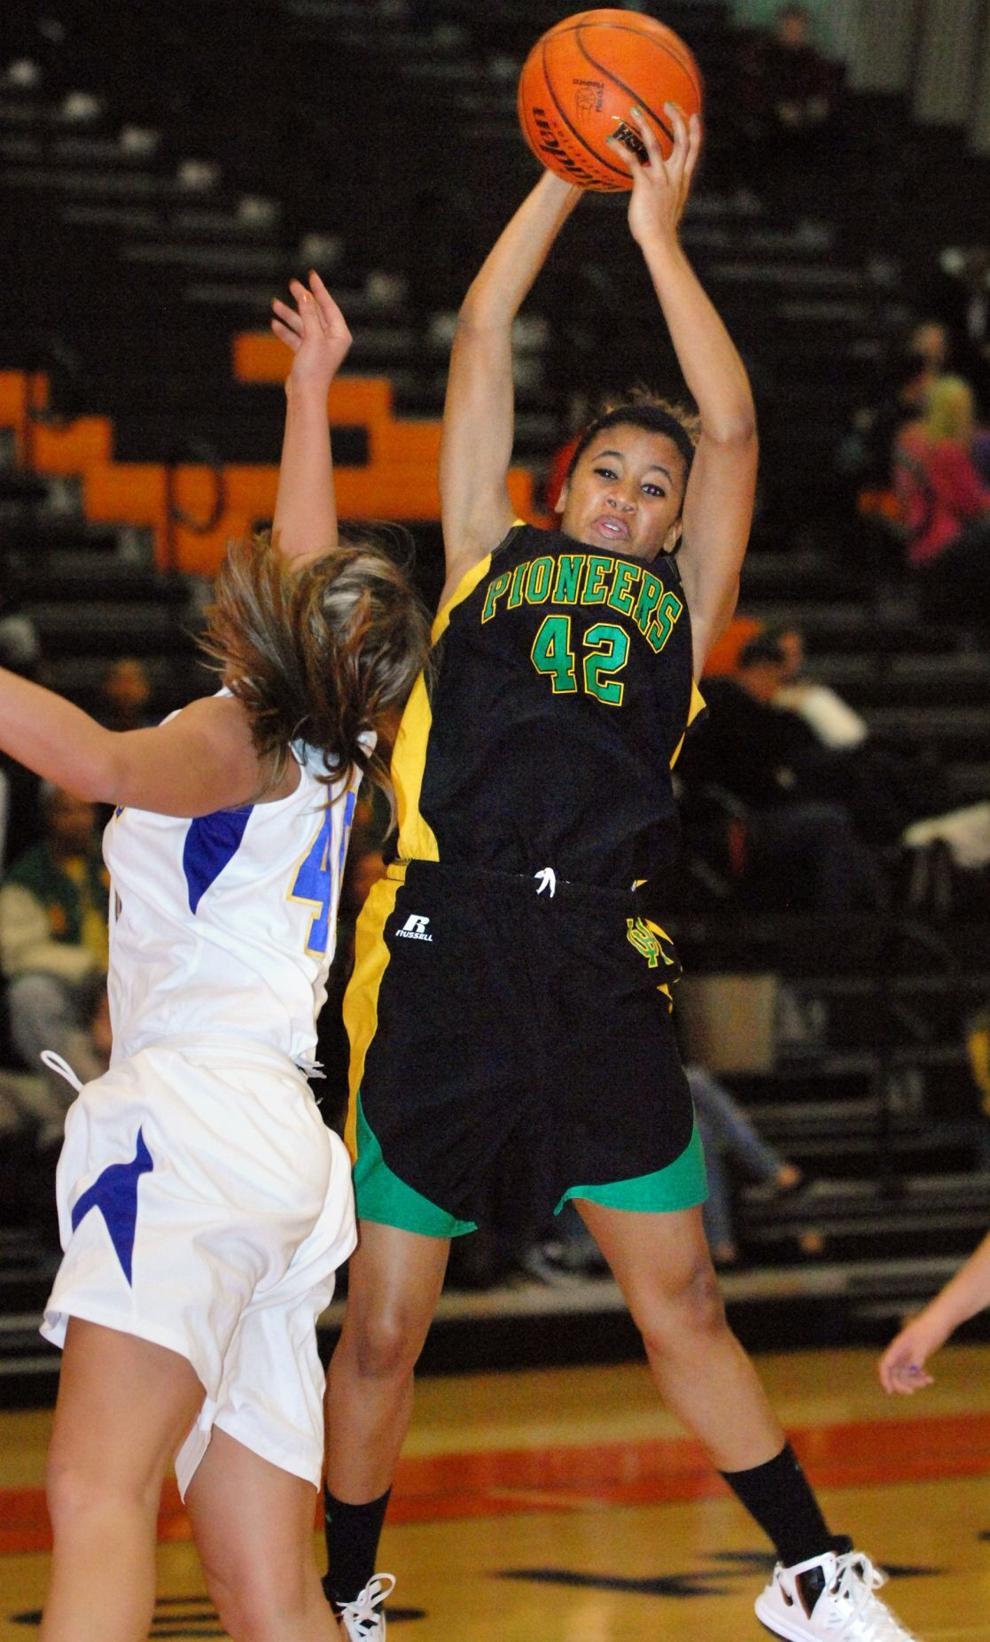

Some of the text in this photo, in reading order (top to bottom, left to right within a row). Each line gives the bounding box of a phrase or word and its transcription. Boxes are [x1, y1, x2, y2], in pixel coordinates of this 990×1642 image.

[481, 554, 683, 655] PIONEERS
[530, 614, 631, 708] 42
[395, 929, 433, 941] RUSSELL
